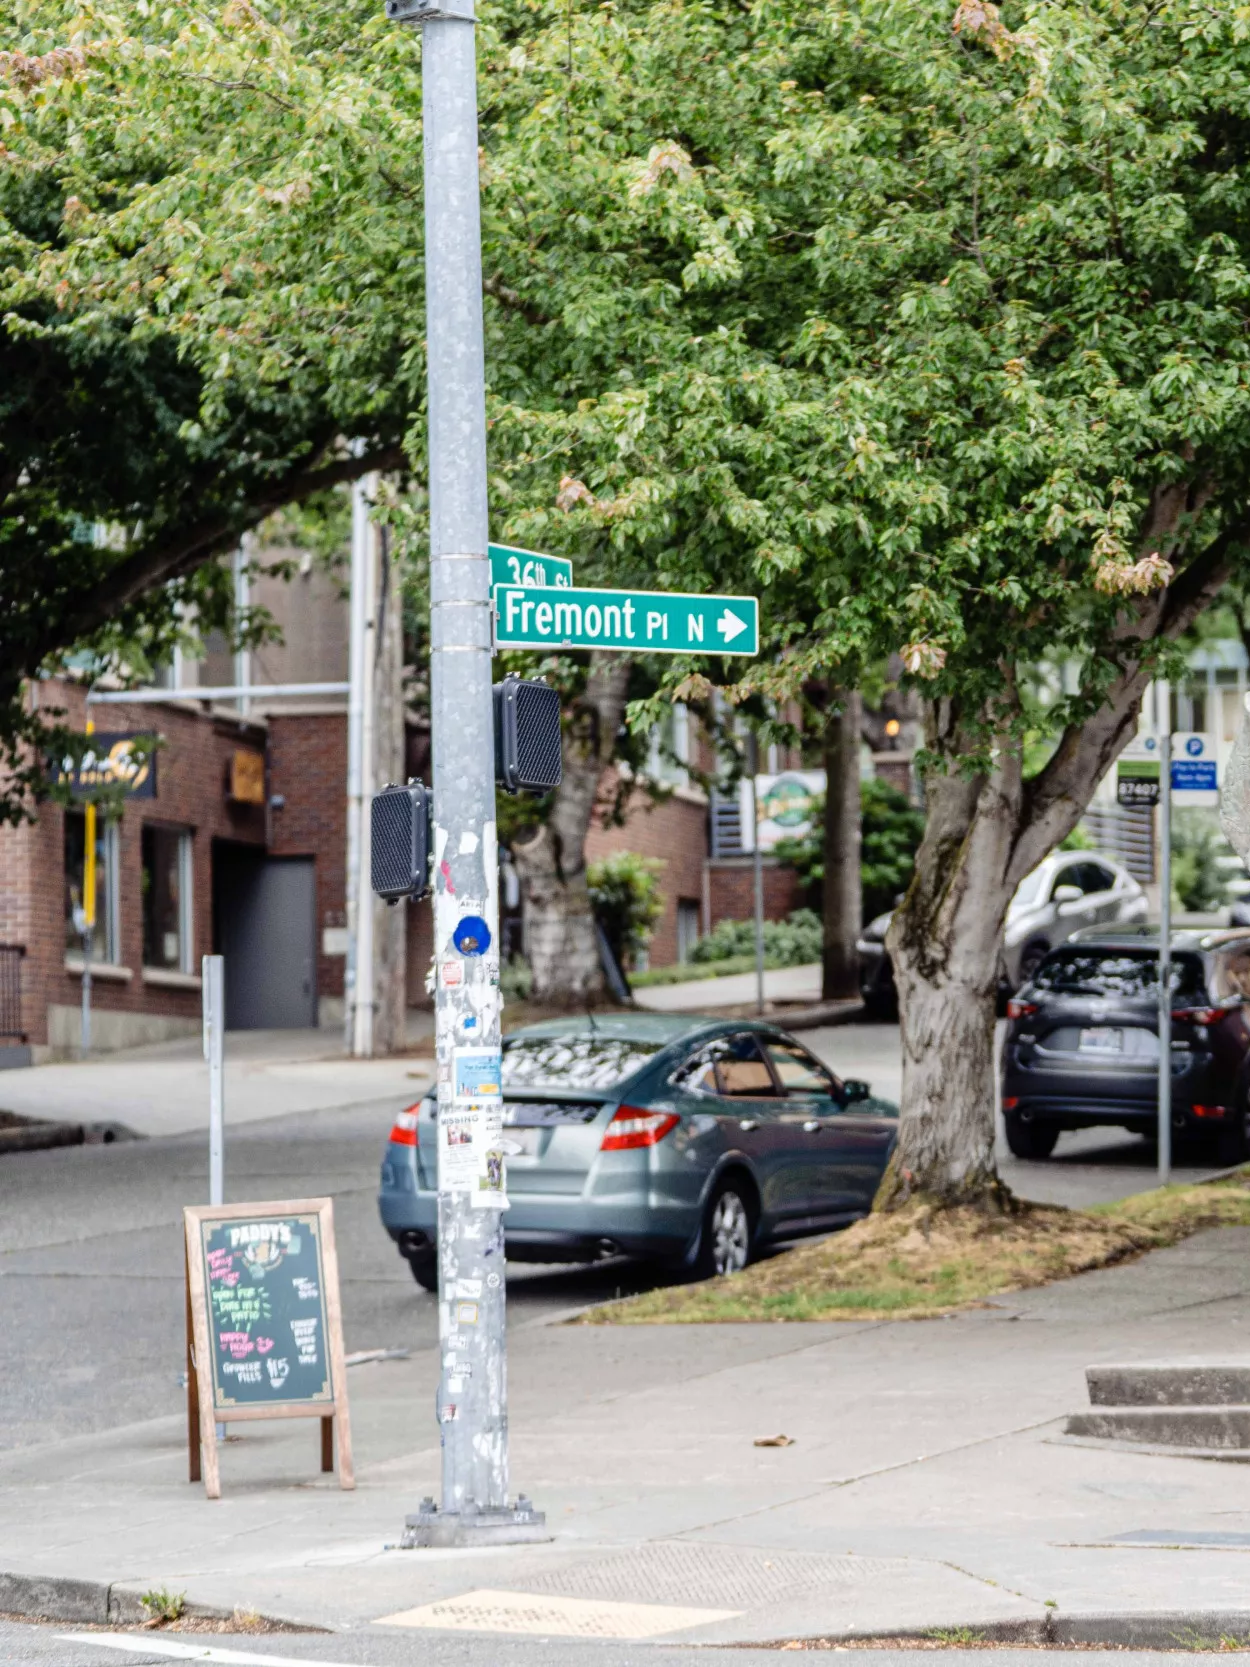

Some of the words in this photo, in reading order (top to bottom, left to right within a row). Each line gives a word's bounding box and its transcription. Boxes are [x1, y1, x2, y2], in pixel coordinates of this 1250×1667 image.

[507, 556, 546, 586] 36th
[555, 572, 568, 587] St
[506, 590, 635, 639] Fremont
[647, 611, 668, 640] Pl
[687, 613, 704, 642] N
[230, 1222, 291, 1249] PADDY'S
